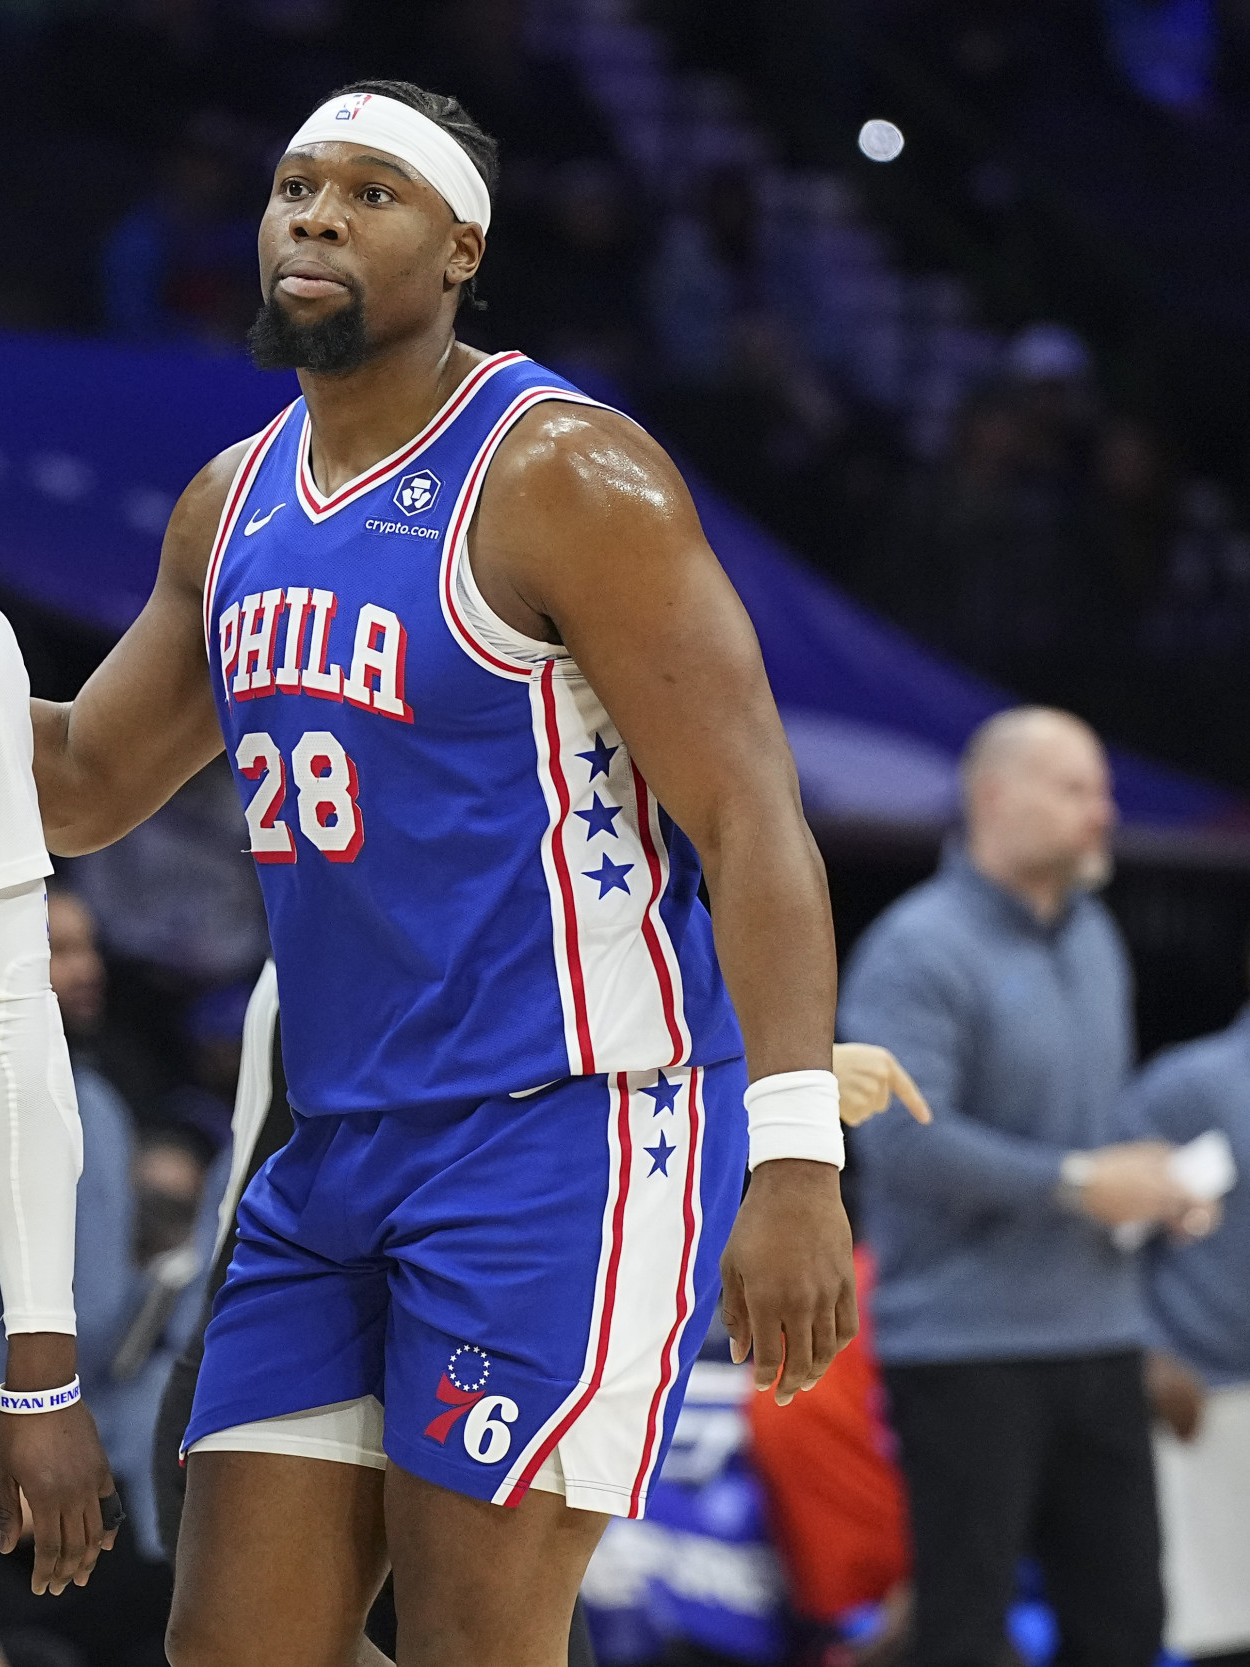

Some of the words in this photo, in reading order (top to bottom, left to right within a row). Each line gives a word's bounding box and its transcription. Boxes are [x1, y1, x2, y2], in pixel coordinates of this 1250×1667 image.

[365, 519, 440, 540] crypto.com
[219, 587, 414, 723] PHILA
[235, 731, 364, 864] 28
[1, 1396, 44, 1409] RYAN
[50, 1385, 81, 1406] HENR
[423, 1371, 519, 1464] 76
